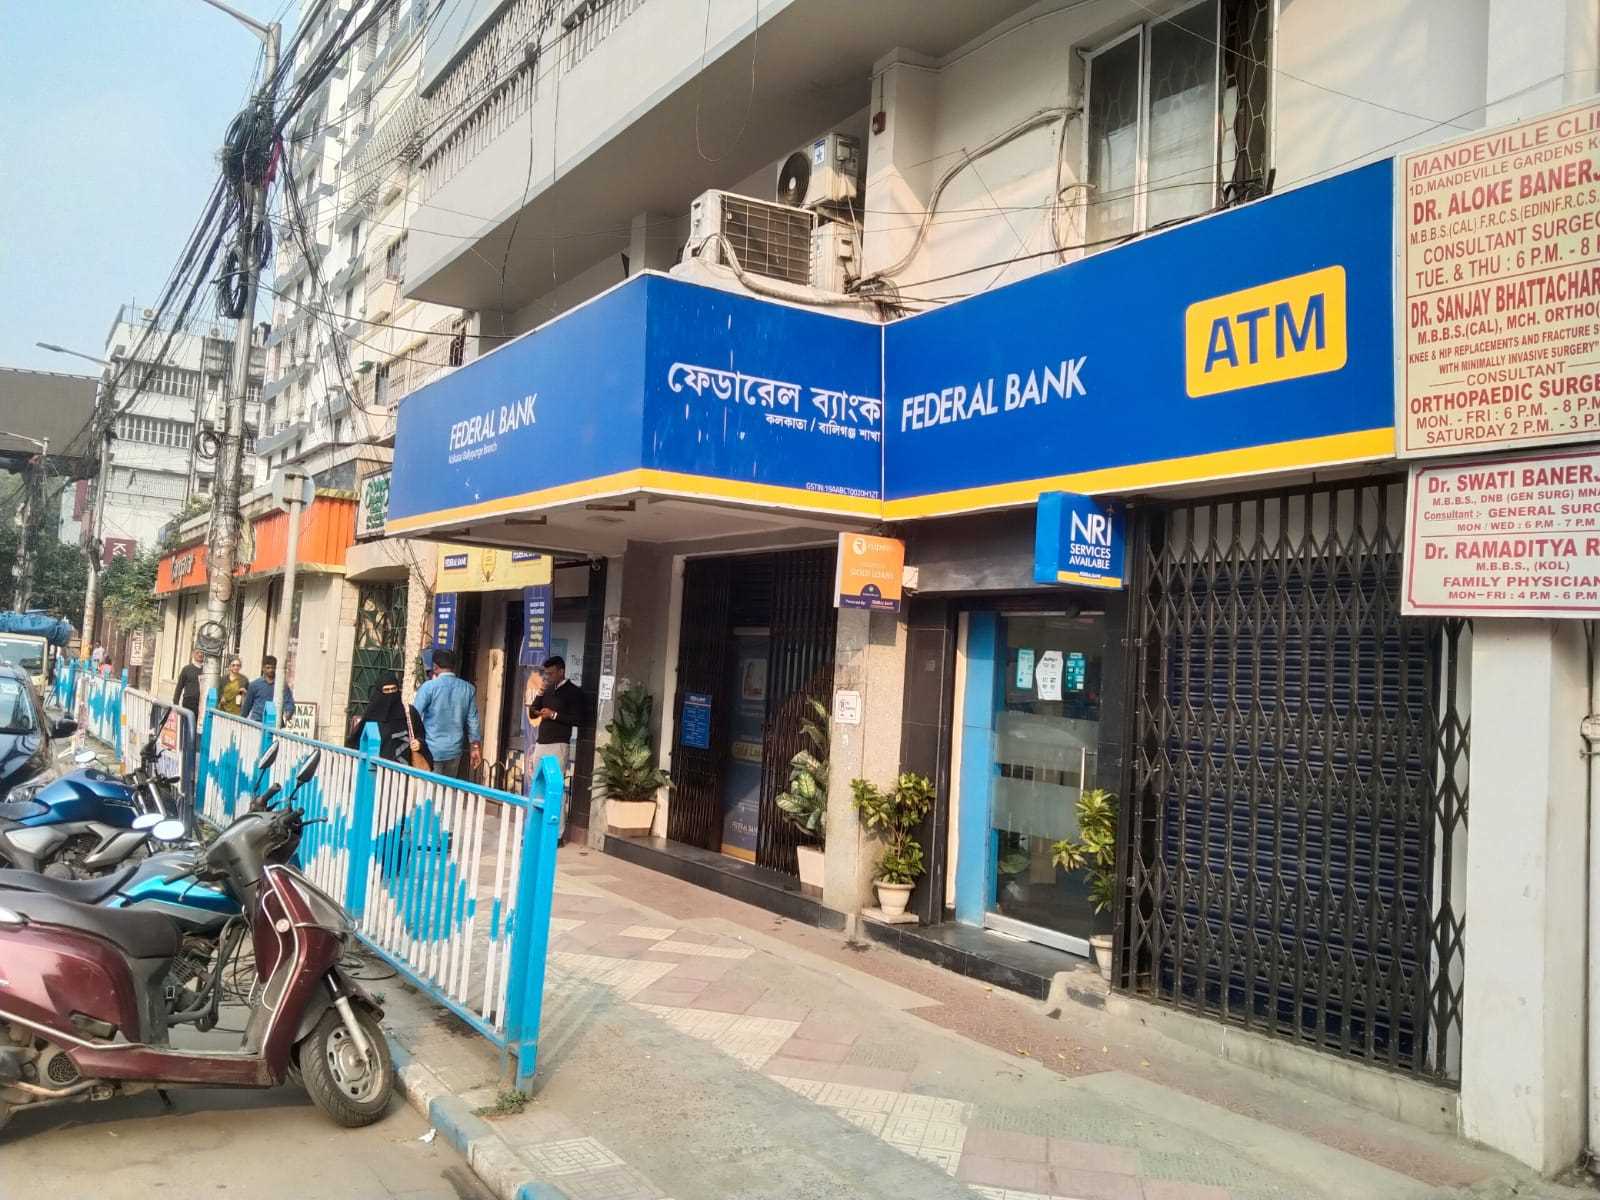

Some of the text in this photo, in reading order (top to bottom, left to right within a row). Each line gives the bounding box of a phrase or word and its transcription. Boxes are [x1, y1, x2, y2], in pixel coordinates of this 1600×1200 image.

[1413, 109, 1600, 178] MANDEVILLE CLI
[1513, 140, 1584, 171] GARDENS
[1588, 135, 1600, 150] K
[1413, 197, 1442, 225] DR.
[1448, 180, 1513, 217] ALOKE
[1424, 226, 1527, 265] CONSULTANT
[1416, 267, 1449, 289] TUE.
[1453, 263, 1464, 281] &
[1469, 254, 1501, 279] THU
[1516, 250, 1525, 269] 6
[1531, 243, 1563, 266] P.M.
[1581, 236, 1590, 256] 8
[1411, 300, 1432, 328] DR.
[1436, 287, 1492, 324] SANJAY
[1506, 311, 1541, 330] MCH.
[1204, 292, 1327, 374] ATM
[1409, 351, 1429, 364] KNEE
[1431, 350, 1437, 361] &
[1439, 347, 1452, 359] HIP
[1454, 336, 1519, 356] REPLACEMENTS
[1521, 333, 1540, 346] AND
[1542, 324, 1590, 343] FRACTURE
[1439, 361, 1460, 374] WITH
[1461, 354, 1505, 372] MINIMALLY
[1508, 348, 1549, 364] INVASIVE
[1466, 361, 1566, 386] CONSULTANT
[667, 361, 882, 426] ফেডারেল ব্যাংক
[901, 355, 1087, 433] FEDERAL BANK
[1410, 382, 1533, 414] ORTHOPAEDIC
[449, 392, 538, 452] FEDERAL BANK
[764, 413, 808, 431] কলকাতা
[1416, 414, 1452, 430] MON.
[1466, 409, 1491, 424] FRI
[1504, 406, 1512, 419] 6
[1517, 402, 1547, 418] P.M.
[1563, 399, 1571, 413] 8
[1426, 423, 1506, 444] SATURDAY
[1510, 422, 1518, 435] 2
[1523, 418, 1554, 434] P.M.
[1569, 415, 1579, 429] 3
[1584, 413, 1600, 428] P.
[1428, 477, 1451, 494] Dr.
[1457, 470, 1515, 492] SWATI
[1480, 494, 1503, 504] DNB
[1506, 492, 1534, 504] (GEN
[1537, 489, 1574, 501] SURG)
[1578, 487, 1600, 498] MN
[1070, 508, 1112, 547] NRI
[1424, 509, 1473, 521] Consultant
[1488, 505, 1556, 518] GENERAL
[1457, 523, 1482, 532] MON
[1490, 521, 1515, 530] WED
[1524, 520, 1532, 528] 6
[1535, 519, 1554, 528] P.M
[1564, 518, 1571, 527] 7
[1575, 517, 1595, 527] P.M
[1068, 556, 1111, 570] AVAILABLE
[1069, 543, 1111, 559] SERVICES
[1424, 542, 1448, 560] Dr.
[1455, 538, 1578, 560] RAMADITYA
[1443, 576, 1501, 587] FAMILY
[1534, 560, 1570, 572] (KOL)
[1518, 591, 1525, 599] 4
[1530, 591, 1551, 600] P.M
[1563, 591, 1571, 600] 6
[1575, 591, 1598, 600] P.M
